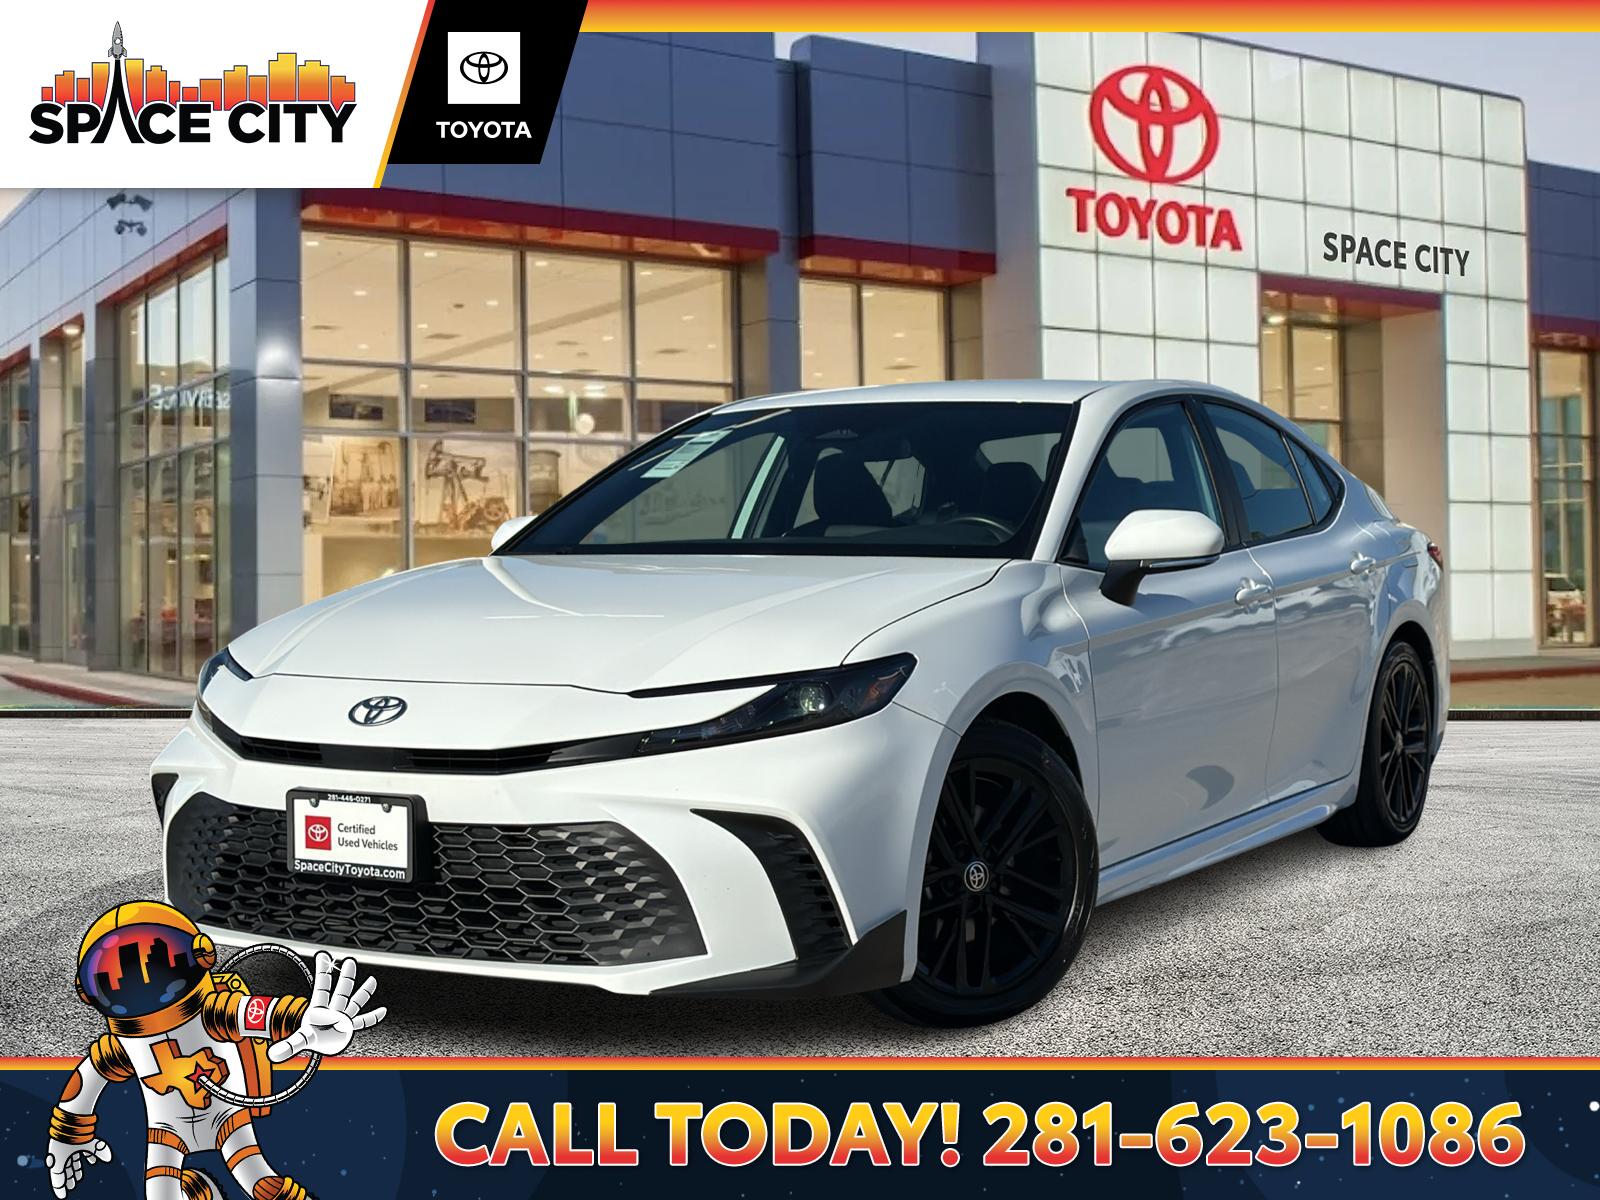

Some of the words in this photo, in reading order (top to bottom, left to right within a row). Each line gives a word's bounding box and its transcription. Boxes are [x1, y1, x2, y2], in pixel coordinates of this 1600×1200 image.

[1066, 188, 1242, 252] TOYOTA
[1323, 232, 1407, 270] SPACE
[1415, 245, 1470, 277] CITY
[337, 822, 376, 835] Certified
[337, 837, 360, 848] Used
[361, 839, 398, 851] Vehicles
[294, 859, 406, 880] SpaceCityToyota.com
